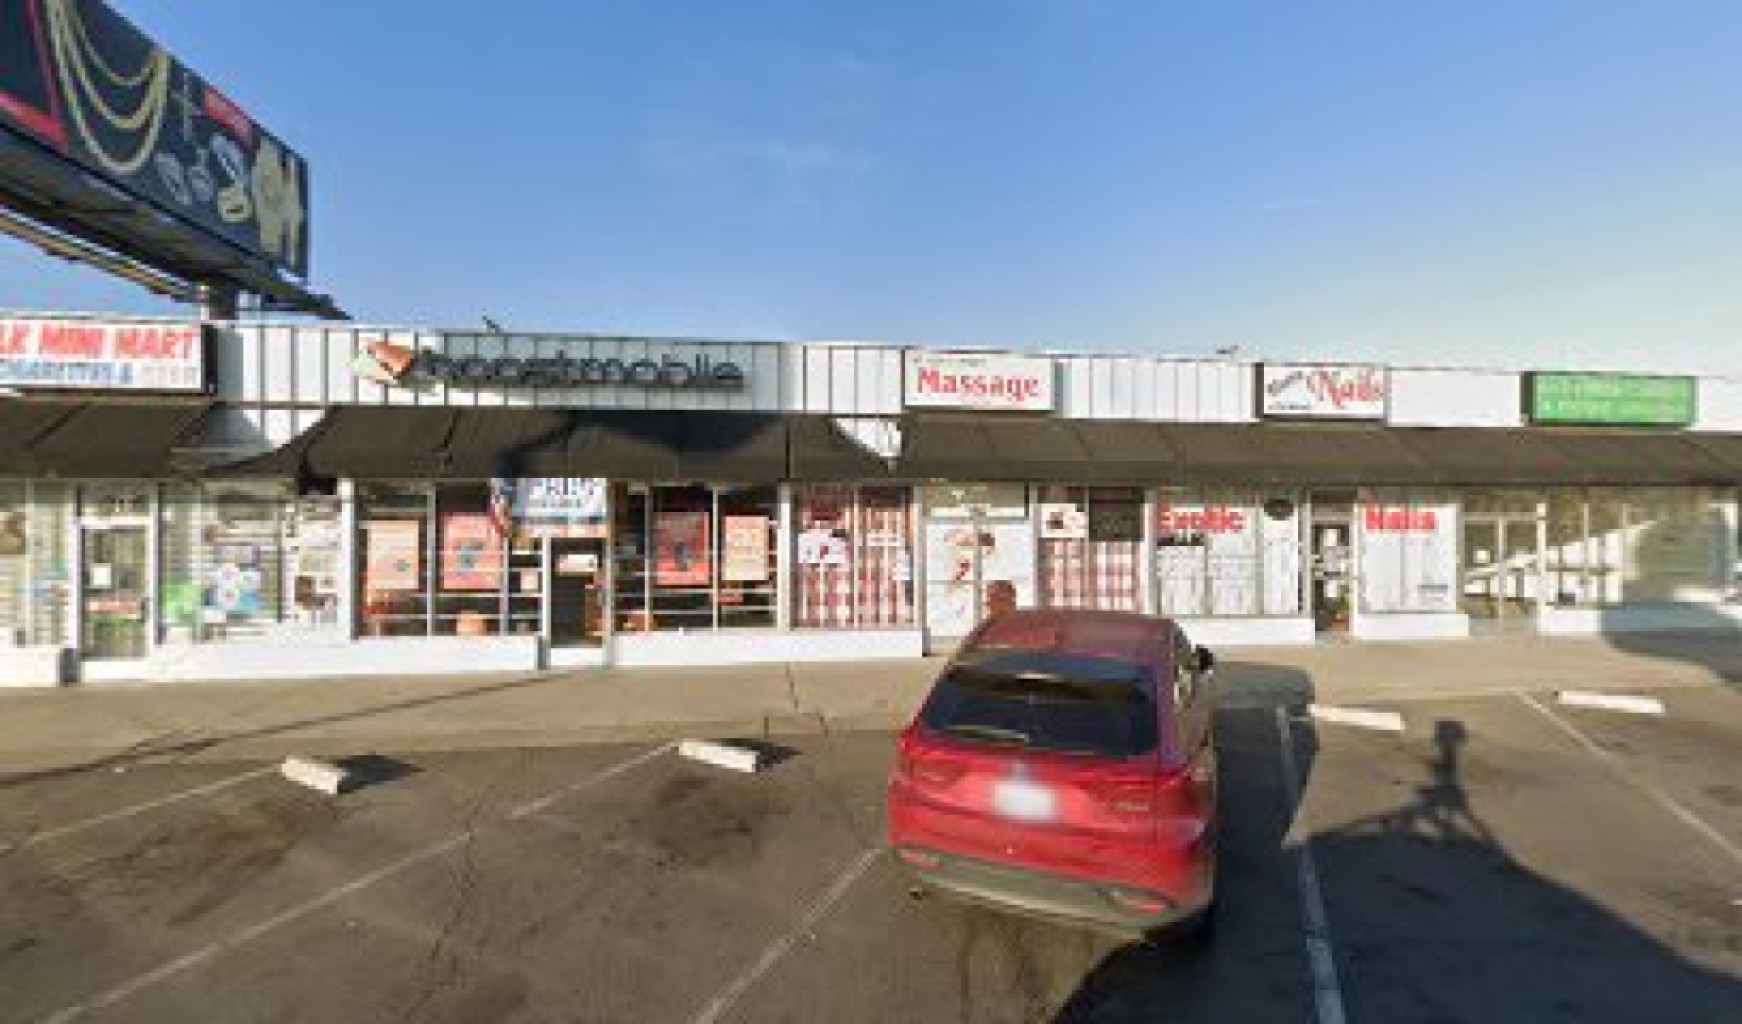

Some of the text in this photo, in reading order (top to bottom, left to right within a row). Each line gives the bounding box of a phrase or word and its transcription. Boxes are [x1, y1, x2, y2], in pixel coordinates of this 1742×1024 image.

[40, 324, 105, 358] MINI
[115, 328, 194, 359] MART
[917, 366, 1040, 402] Massage
[1304, 367, 1386, 410] Nails
